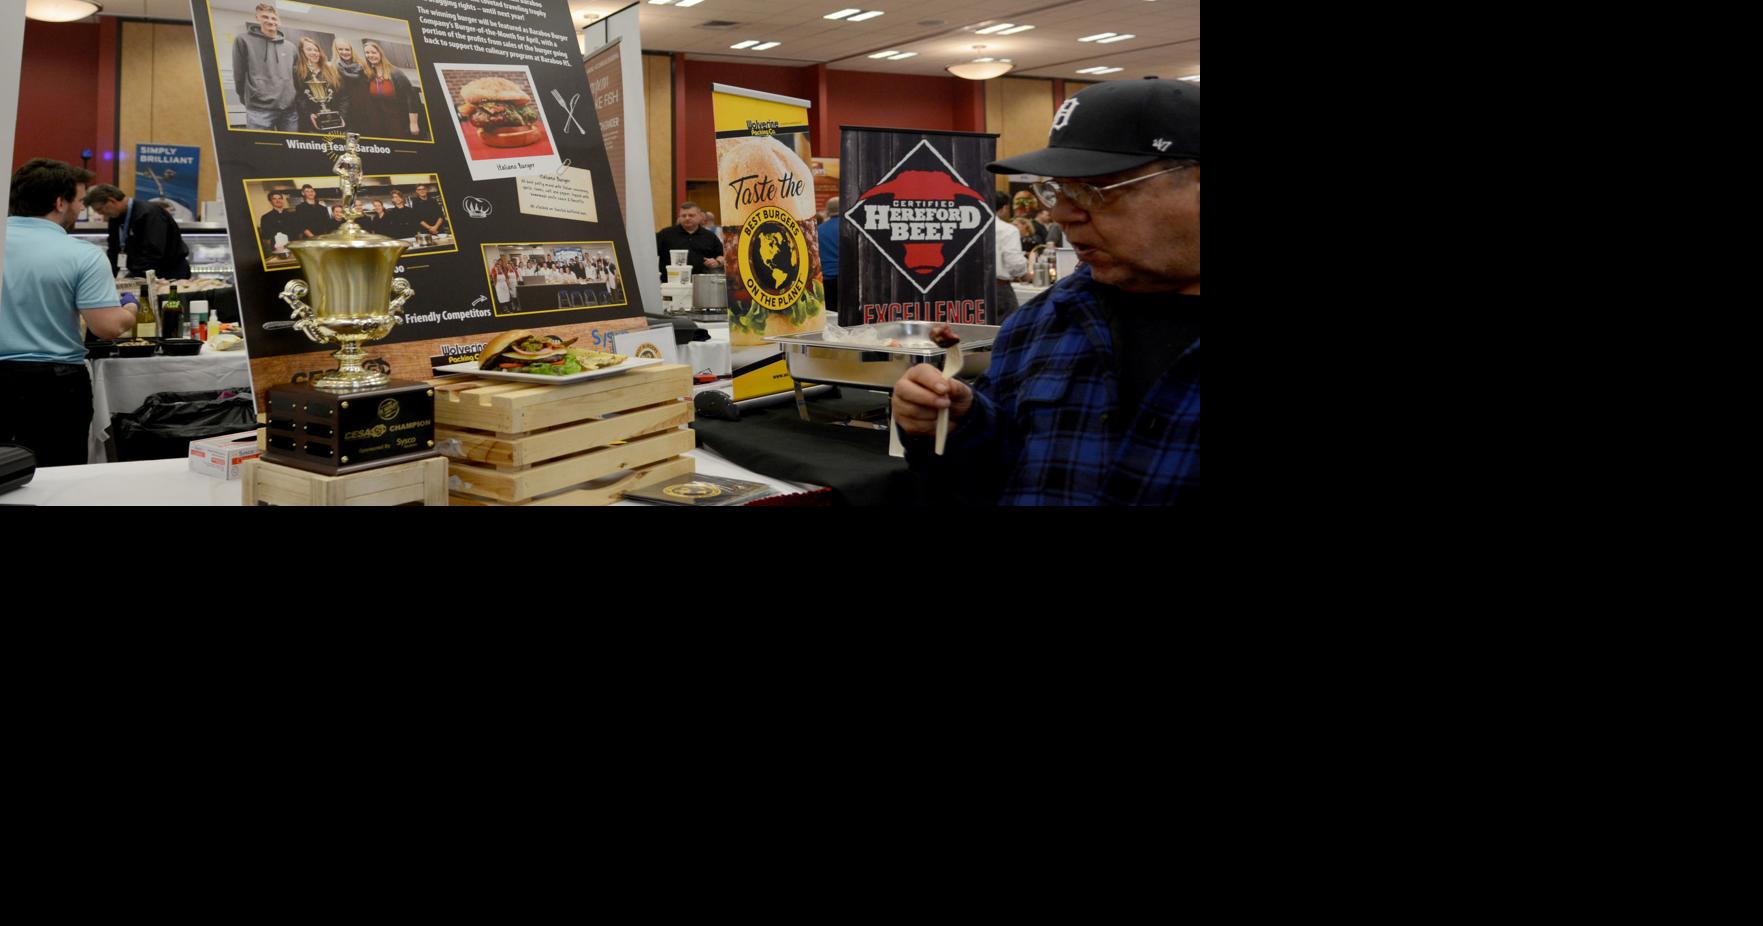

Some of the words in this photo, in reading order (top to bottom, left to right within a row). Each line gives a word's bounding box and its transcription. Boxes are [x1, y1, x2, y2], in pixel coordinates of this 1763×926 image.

[458, 2, 476, 10] rights
[503, 2, 529, 14] traveling
[528, 8, 546, 18] trophy
[416, 5, 429, 14] The
[430, 10, 456, 21] winning
[456, 13, 477, 23] burger
[498, 21, 521, 32] featured
[529, 28, 551, 37] Baraboo
[551, 32, 568, 41] Burger
[419, 16, 454, 29] Company's
[422, 28, 447, 36] portion
[467, 35, 487, 43] profits
[487, 37, 502, 46] from
[534, 46, 552, 55] burger
[553, 50, 568, 59] going
[424, 36, 440, 45] back
[448, 41, 473, 50] support
[474, 44, 485, 52] the
[485, 47, 508, 57] culinary
[509, 52, 533, 60] program
[540, 56, 562, 65] Baraboo
[140, 146, 177, 155] SIMPLY
[286, 139, 328, 152] Winning
[330, 141, 347, 152] Tea
[140, 155, 193, 164] BRILLIANT
[729, 174, 778, 210] Taste
[778, 171, 806, 199] the
[744, 213, 762, 236] BEST
[762, 209, 800, 236] BURGERS
[864, 204, 982, 230] HEREFORD
[890, 222, 957, 241] BEEF
[747, 278, 760, 296] ON
[760, 292, 777, 307] THE
[777, 279, 804, 308] PLANET
[405, 311, 441, 324] Friendly
[442, 308, 491, 322] Competitors
[863, 299, 986, 324] EXCELLENCE
[448, 355, 474, 363] Packing
[389, 420, 431, 432] CHAMPION
[396, 437, 416, 447] Sysco
